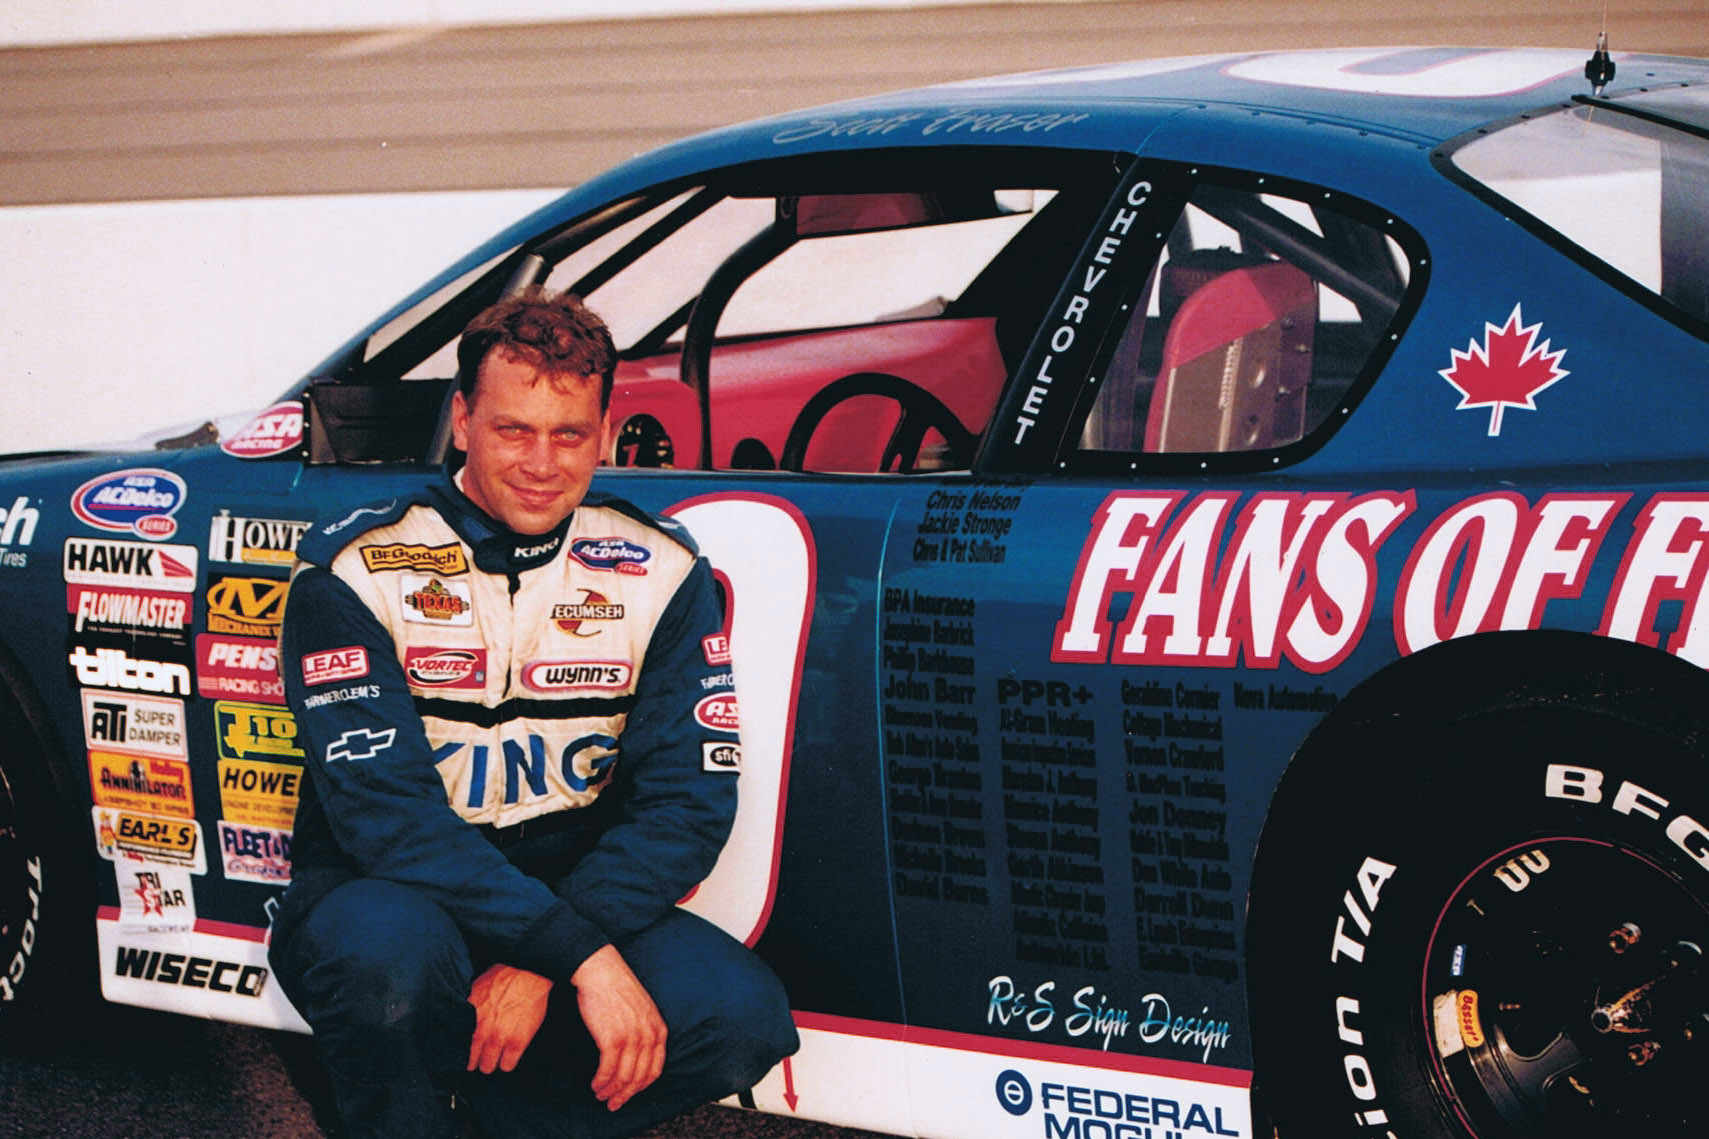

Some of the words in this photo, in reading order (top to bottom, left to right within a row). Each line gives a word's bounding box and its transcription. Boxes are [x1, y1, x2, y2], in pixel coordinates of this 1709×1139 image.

[1014, 181, 1152, 444] CHEVROLET
[927, 490, 967, 511] Chris
[968, 491, 1021, 512] Nelson
[917, 511, 960, 535] Jackie
[68, 543, 155, 577] HAWK
[1051, 488, 1416, 674] FANS
[1393, 490, 1633, 657] OF
[75, 590, 186, 632] FLOWMASTER
[69, 646, 191, 696] tilton
[304, 651, 361, 676] LEAF
[415, 659, 471, 673] VORTEC
[885, 674, 930, 701] John
[935, 677, 975, 704] Barr
[129, 727, 181, 746] DAMPER
[134, 709, 175, 727] SUPER
[223, 767, 297, 796] HOWE
[432, 733, 618, 808] ING
[1331, 856, 1397, 963] T/A
[115, 946, 268, 998] WISECO
[1065, 986, 1131, 1051] Sign
[1139, 993, 1231, 1063] Design
[1336, 996, 1398, 1139] ion
[1041, 1082, 1239, 1138] FEDERAL
